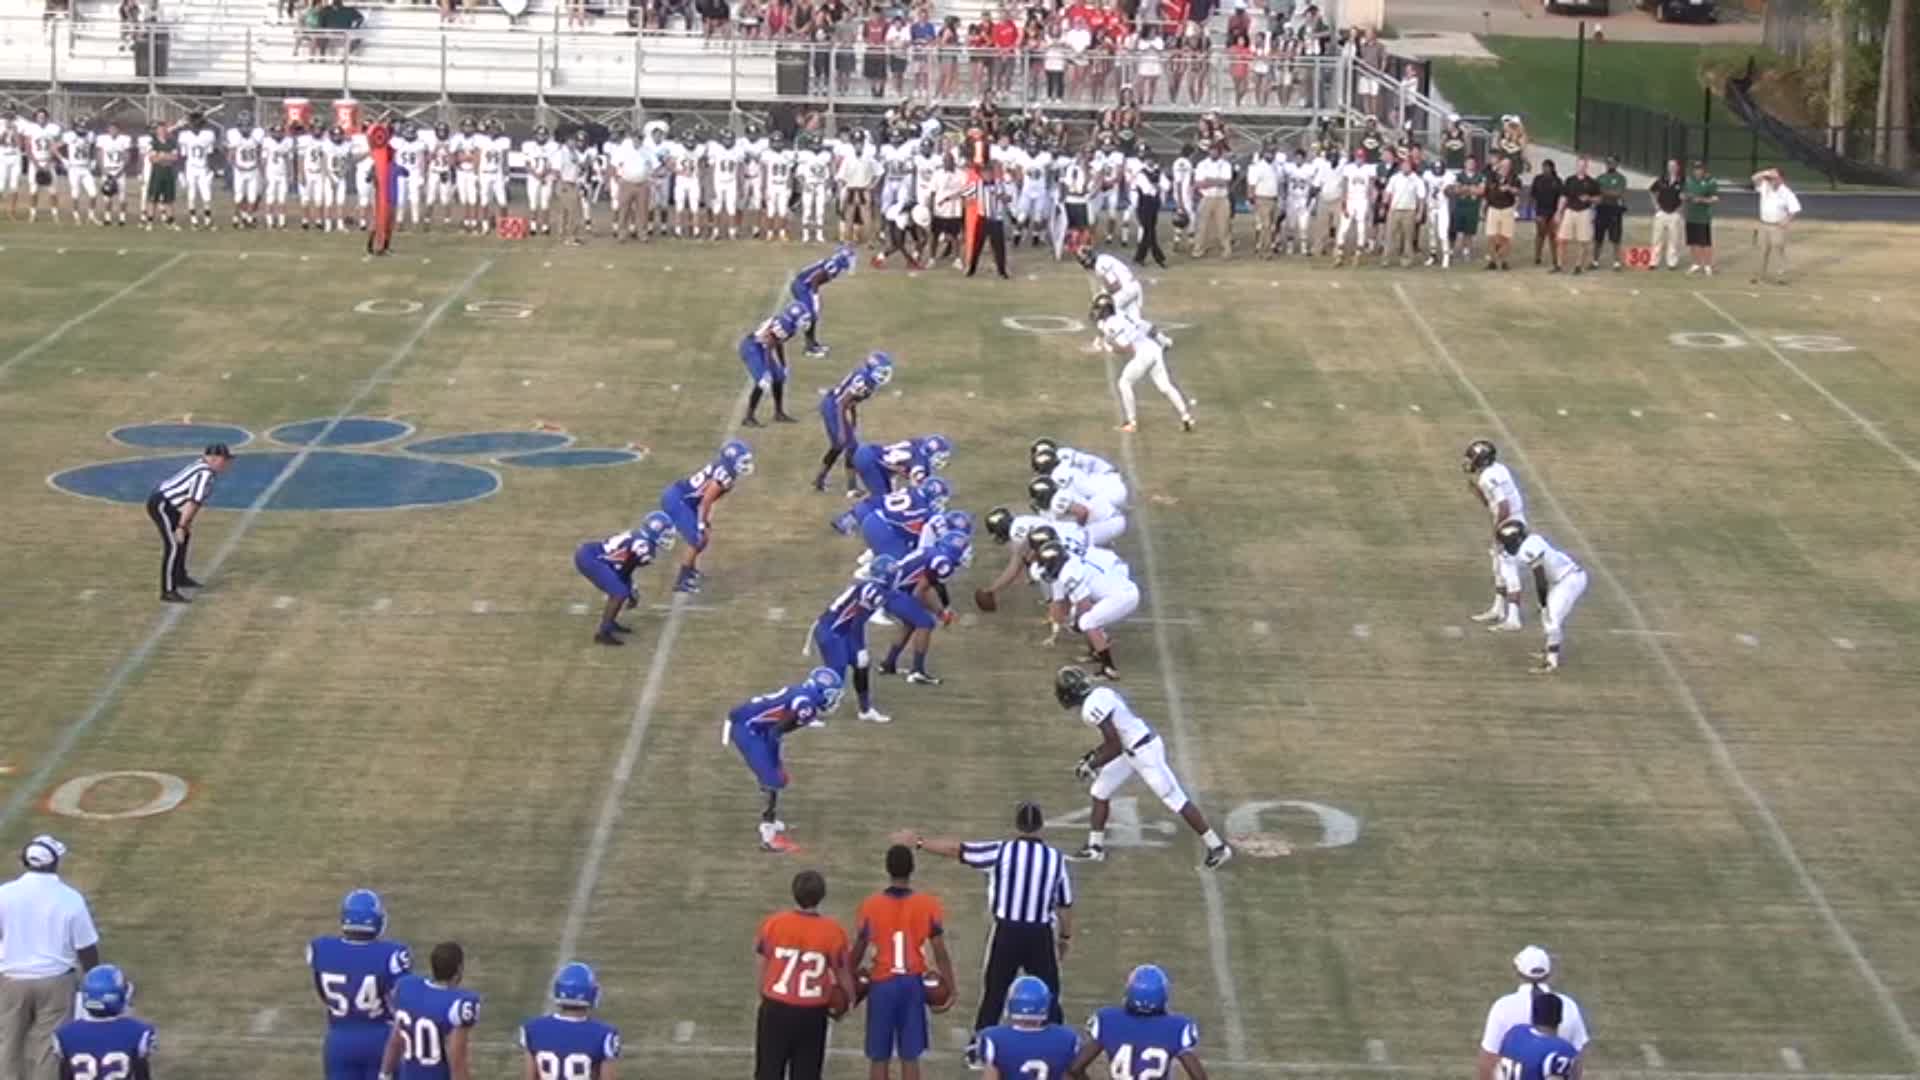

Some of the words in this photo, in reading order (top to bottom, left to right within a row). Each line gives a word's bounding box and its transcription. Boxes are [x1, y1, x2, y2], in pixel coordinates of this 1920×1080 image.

[772, 947, 826, 998] 72
[890, 931, 907, 974] 1
[320, 972, 384, 1018] 54
[1110, 1043, 1168, 1080] 42
